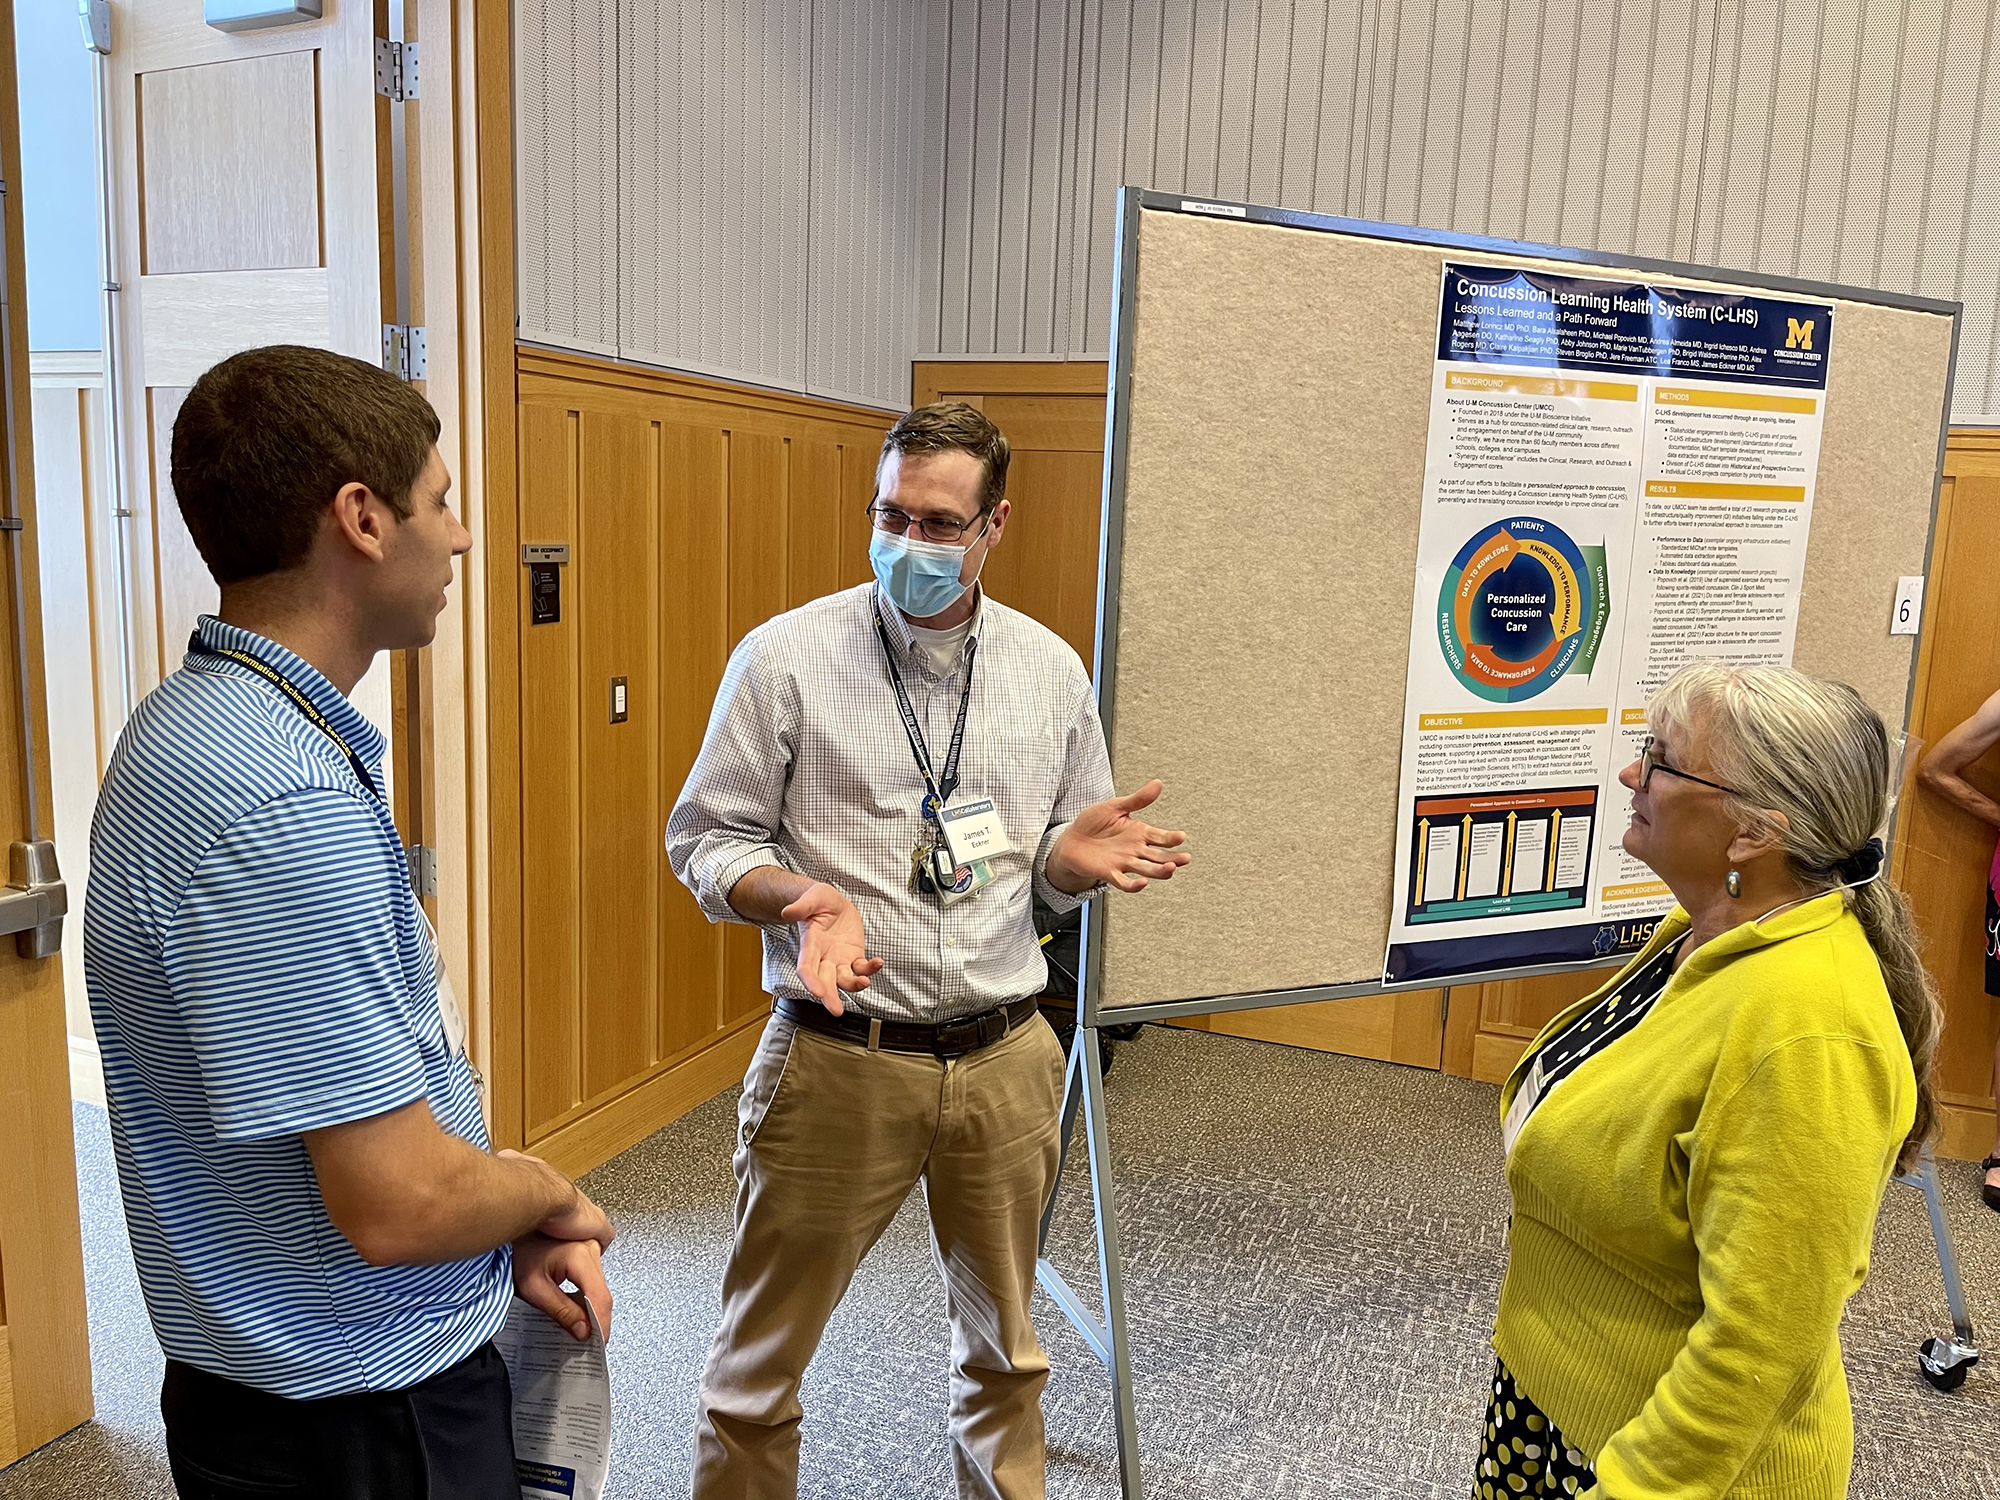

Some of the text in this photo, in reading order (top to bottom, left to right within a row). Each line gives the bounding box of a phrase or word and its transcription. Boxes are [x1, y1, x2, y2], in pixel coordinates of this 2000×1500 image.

[1455, 302, 1617, 326] Lessons Learned and a Path Forward
[1457, 279, 1759, 329] Concussion Learning Health System (C-LHS)
[1453, 319, 1480, 328] Matthew
[1533, 326, 1546, 334] Bara
[1593, 331, 1613, 340] Michael
[1614, 333, 1636, 344] Popovich
[1649, 336, 1668, 345] Andrea
[1669, 338, 1691, 347] Almeida
[1703, 341, 1717, 351] Ingrid
[1749, 345, 1767, 354] Andrea
[1786, 318, 1814, 350] M
[1452, 339, 1474, 350] Rogers
[1490, 342, 1507, 351] Claire
[1509, 343, 1538, 355] Kalpakjian
[1556, 347, 1574, 356] Steven
[1610, 352, 1620, 360] Jere
[1622, 353, 1644, 362] Freeman
[1659, 356, 1670, 364] Lea
[1671, 357, 1689, 365] Franco
[1701, 359, 1717, 368] James
[1718, 360, 1735, 369] Eckner
[1495, 333, 1523, 342] Katharine
[1561, 338, 1575, 349] Abby
[1576, 340, 1598, 349] Johnson
[1614, 343, 1627, 351] Marie
[1681, 349, 1696, 359] Brigid
[1751, 354, 1761, 363] Alex
[1774, 350, 1803, 359] CONCUSSION
[1451, 376, 1504, 388] BACKGROUND
[1478, 400, 1512, 408] Concussion
[1533, 403, 1554, 412] (UMCC)
[1659, 392, 1690, 401] METHODS
[1650, 485, 1676, 493] RESULTS
[1510, 520, 1544, 532] PATIENTS
[1462, 544, 1510, 598] DATA TO KOWLEDGE
[1529, 544, 1572, 635] KNOWLEDGE TO PERFORMANCE
[1596, 565, 1605, 602] Outreach
[1487, 593, 1546, 605] Personalized
[1900, 599, 1911, 622] 6
[1490, 607, 1542, 619] Concussion
[1506, 621, 1528, 632] Care
[1586, 610, 1605, 658] Engagement
[1441, 612, 1462, 671] RESEARCHERS
[1470, 652, 1536, 679] PERFORMANCE TO DATA
[1550, 638, 1579, 679] CLINICIANS
[232, 651, 353, 758] Information Technology & Services
[1424, 718, 1464, 726] OBJECTIVE
[963, 829, 985, 840] James
[971, 839, 990, 848] Eckner
